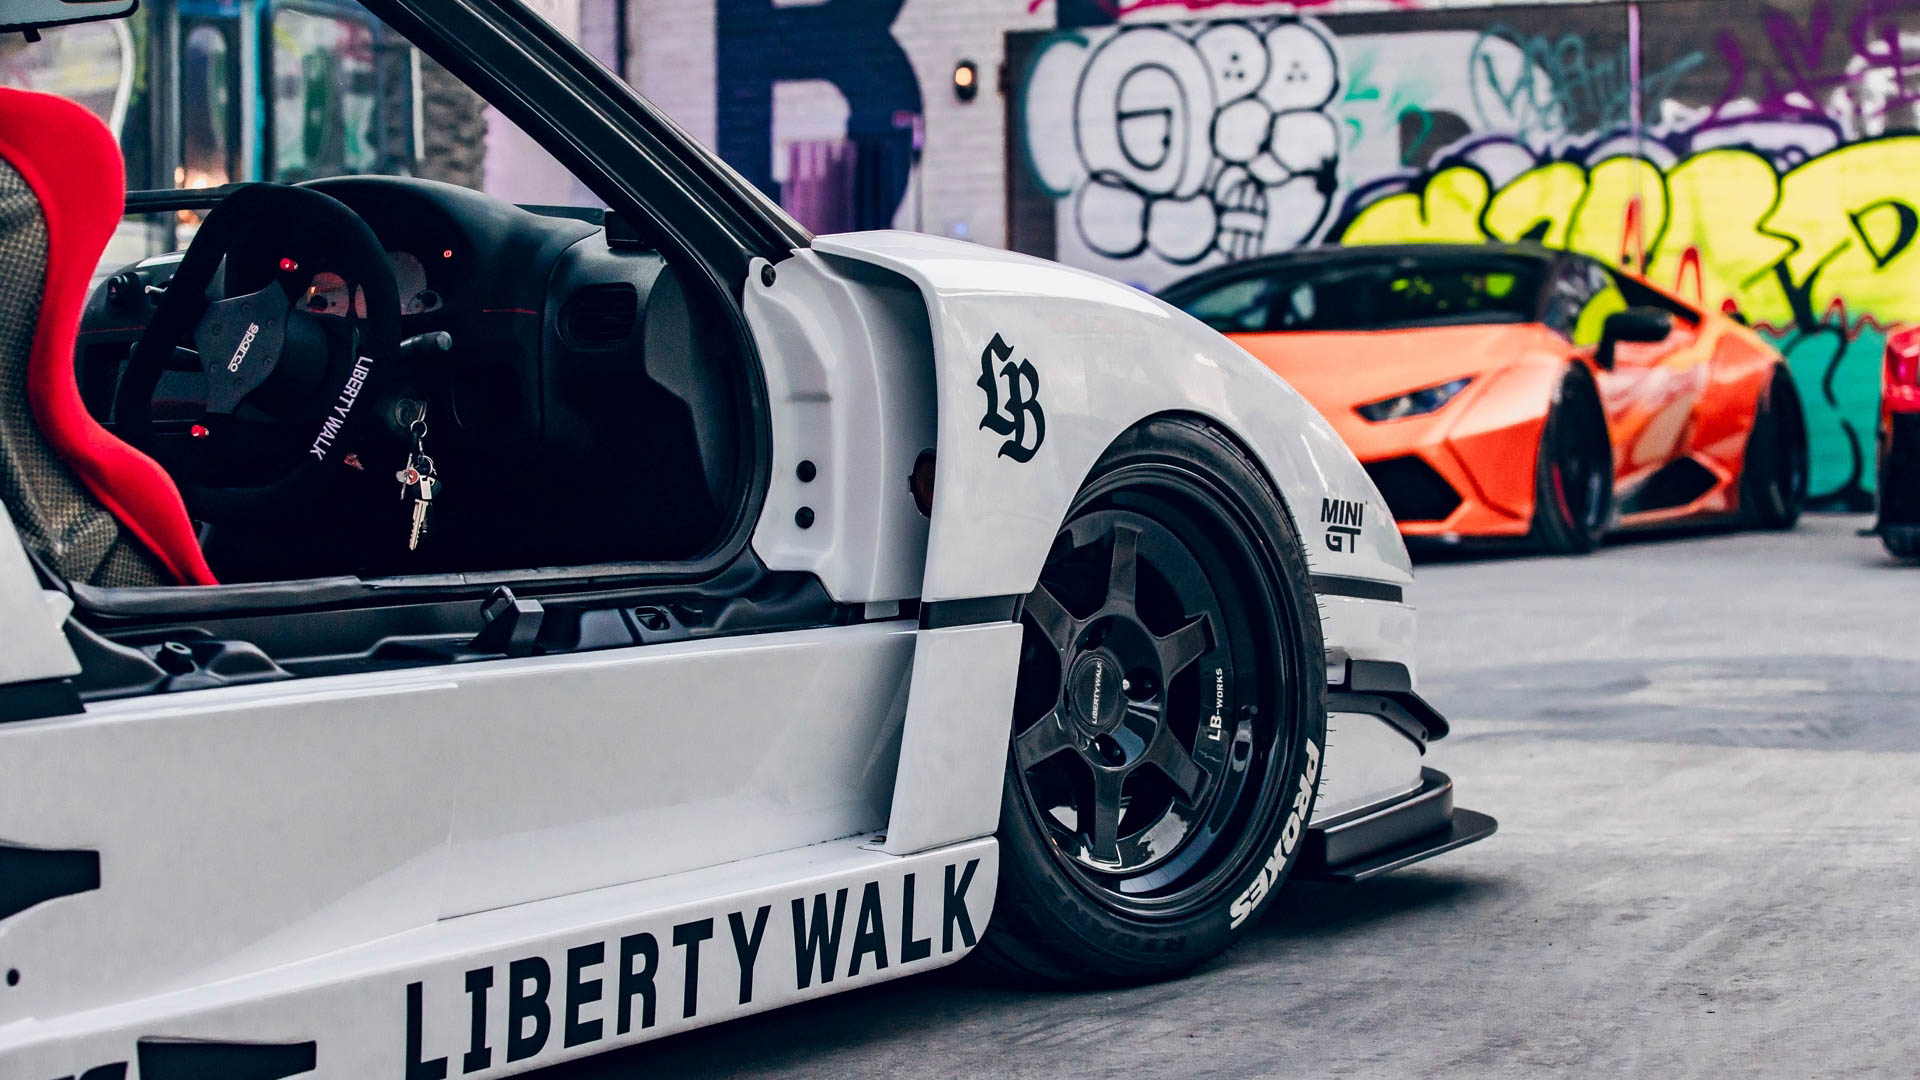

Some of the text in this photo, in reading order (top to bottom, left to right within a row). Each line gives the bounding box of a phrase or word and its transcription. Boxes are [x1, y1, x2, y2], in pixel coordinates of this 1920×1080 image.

[227, 322, 259, 372] sparco
[309, 356, 374, 461] LIBERTY WALK
[1320, 497, 1364, 527] MINI
[1325, 525, 1362, 554] GT
[1229, 737, 1320, 931] PROXES
[405, 858, 981, 1080] LIBERTY WALK
